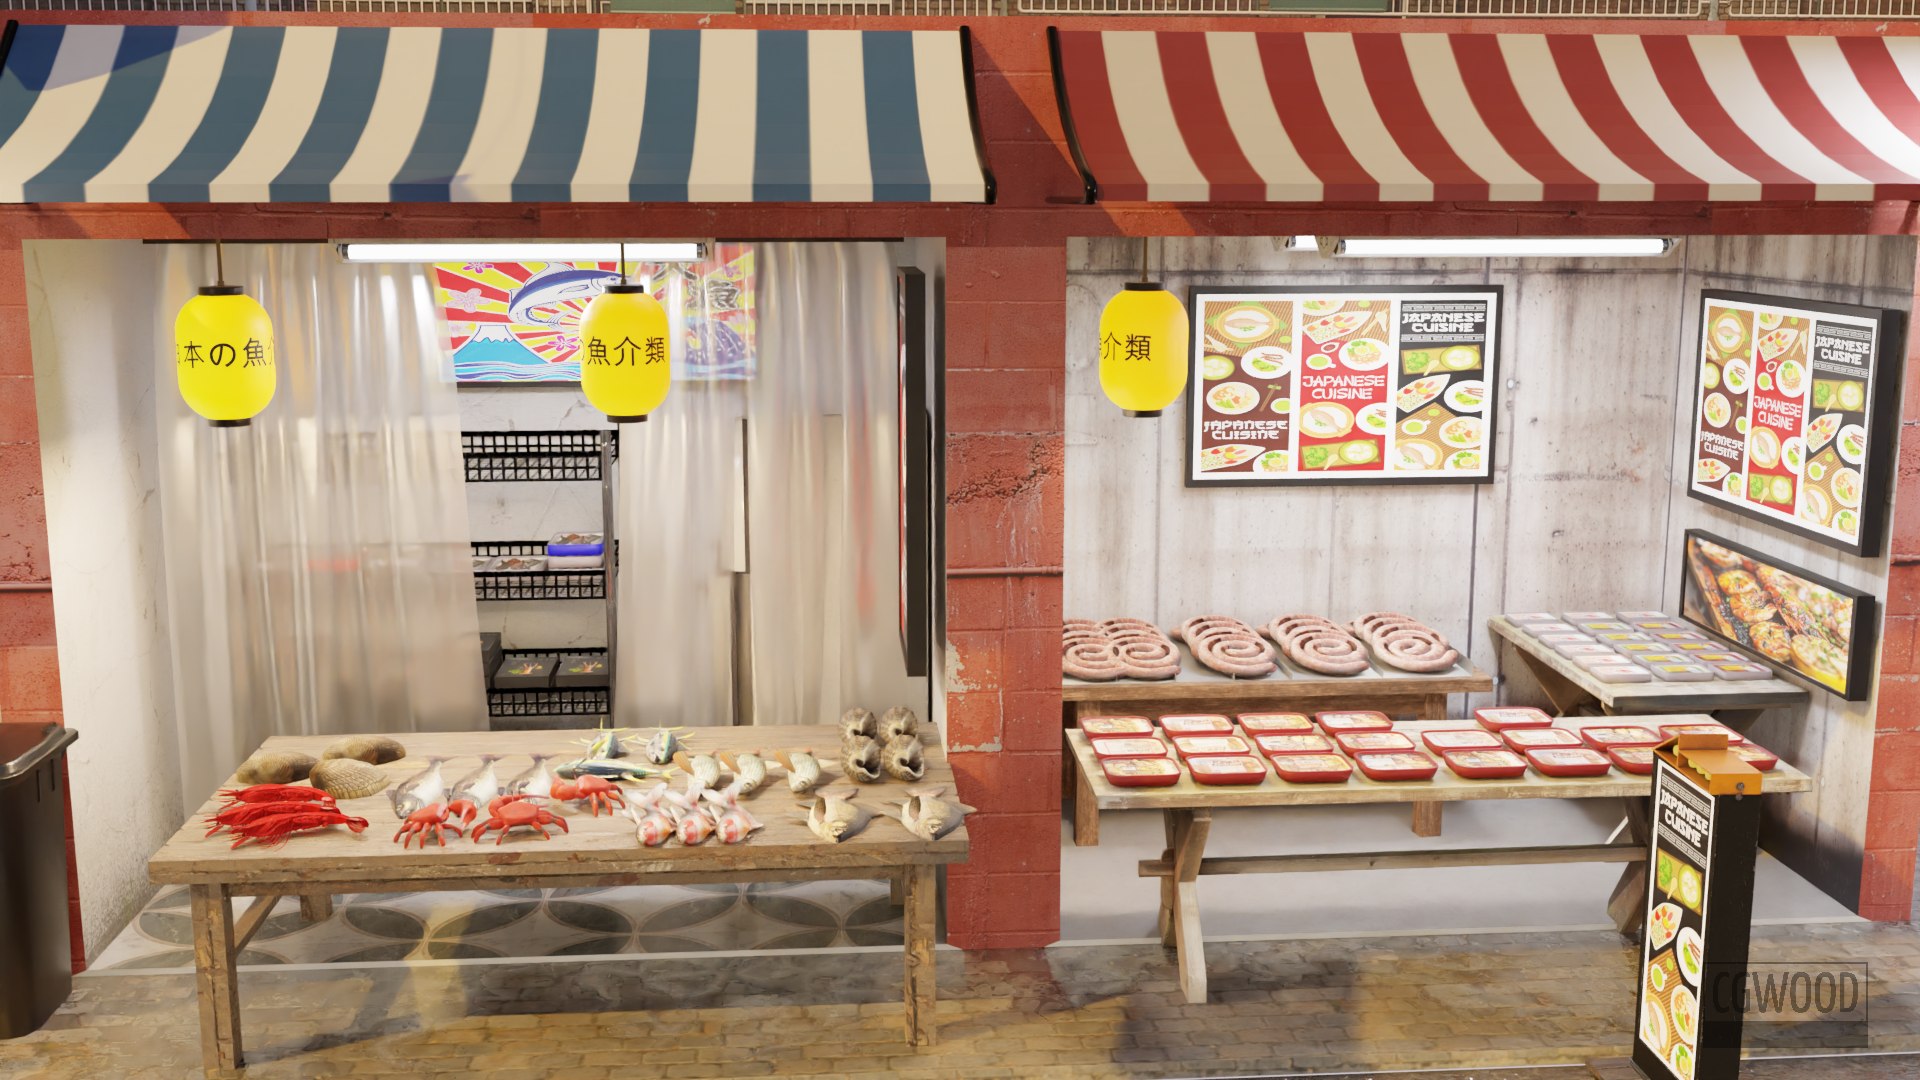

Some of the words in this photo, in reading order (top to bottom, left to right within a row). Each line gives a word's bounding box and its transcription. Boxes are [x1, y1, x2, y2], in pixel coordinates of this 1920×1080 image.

[1402, 312, 1485, 324] JAPANESE
[1411, 322, 1474, 333] CUISINE
[176, 338, 274, 368] 本の魚
[580, 336, 666, 367] 魚介類
[1099, 332, 1152, 362] 介類
[1816, 336, 1870, 355] JAPANESE
[1821, 348, 1862, 365] CUISINE
[1302, 375, 1386, 387] JAPANESE
[1311, 388, 1373, 400] CUISINE
[1753, 395, 1802, 418] JAPANESE
[1203, 420, 1288, 432] JAPANESE
[1758, 410, 1794, 430] CUISINE
[1212, 430, 1279, 440] CUISINE
[1700, 430, 1744, 451] JAPANESE
[1660, 788, 1709, 836] JAPANESE
[1665, 808, 1702, 848] CUISINE
